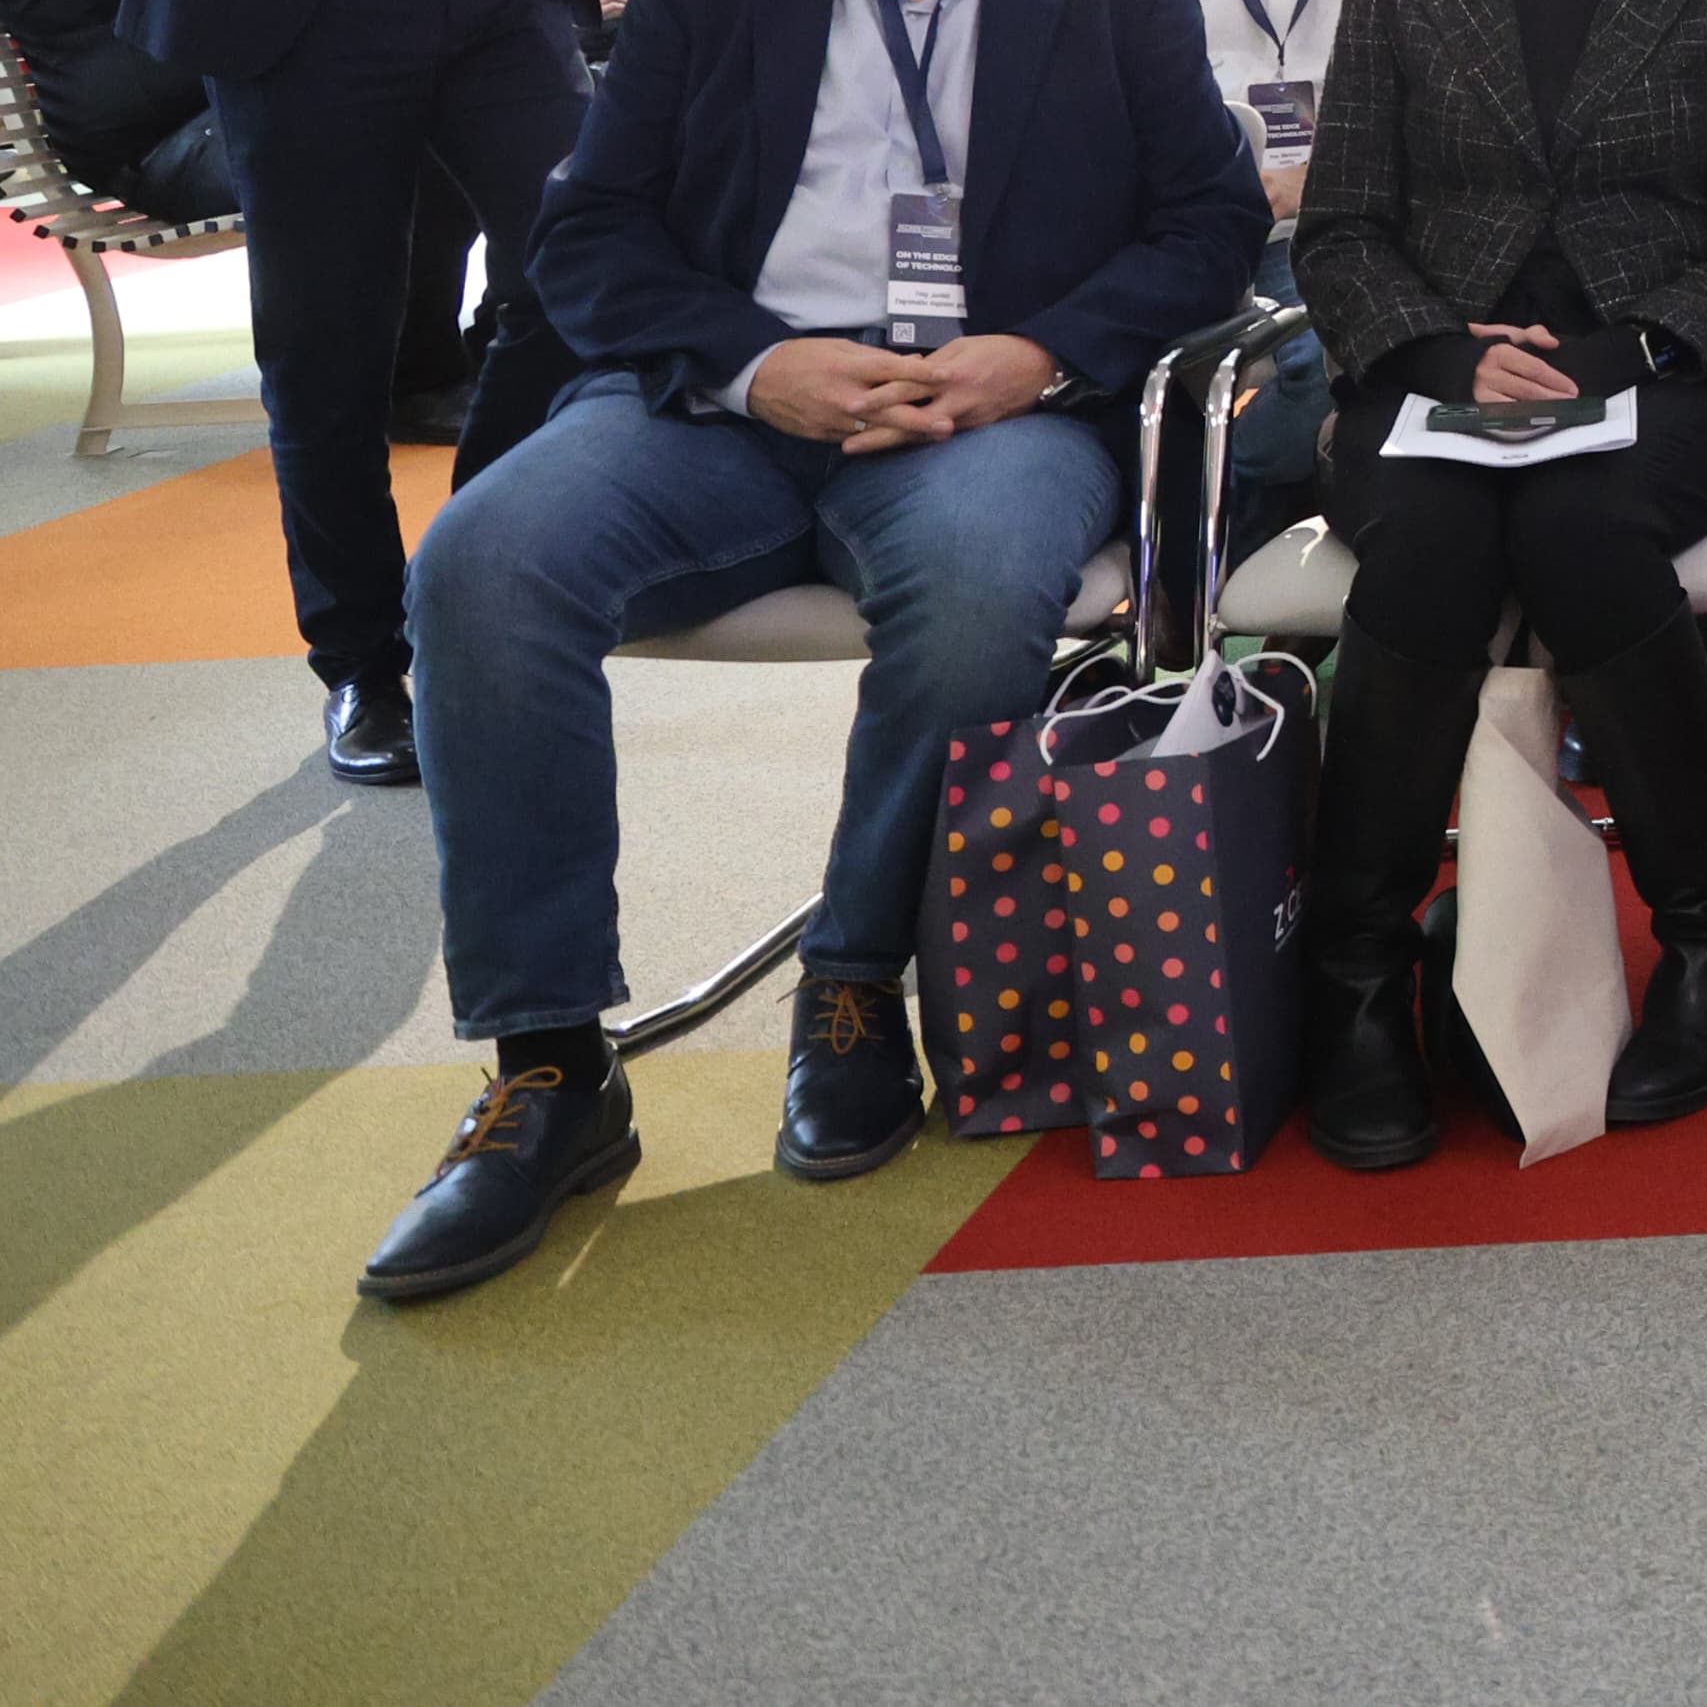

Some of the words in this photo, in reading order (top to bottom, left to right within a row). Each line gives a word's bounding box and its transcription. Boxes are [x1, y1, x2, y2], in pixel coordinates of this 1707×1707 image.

[896, 250, 910, 258] ON
[913, 251, 930, 260] THE
[933, 252, 957, 261] EDGE
[896, 260, 909, 268] OF
[911, 261, 962, 272] TECHNOLO
